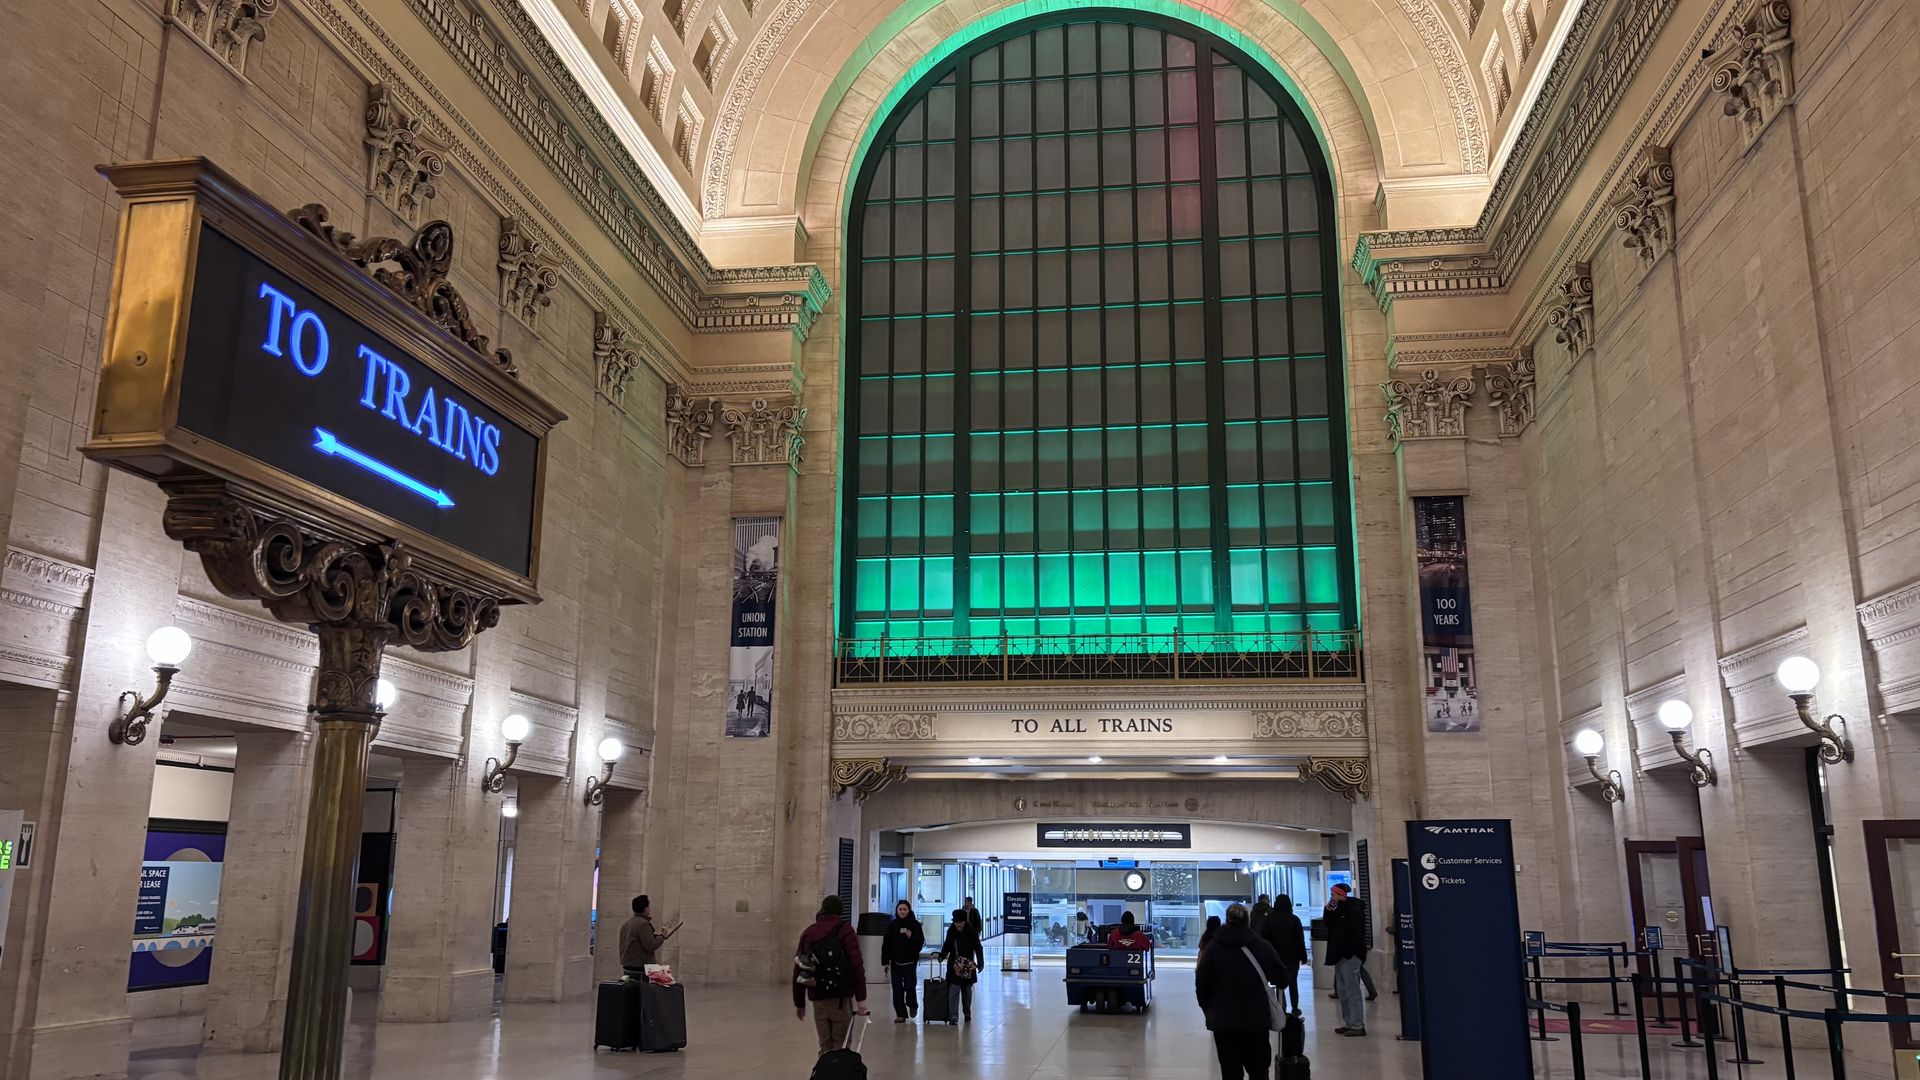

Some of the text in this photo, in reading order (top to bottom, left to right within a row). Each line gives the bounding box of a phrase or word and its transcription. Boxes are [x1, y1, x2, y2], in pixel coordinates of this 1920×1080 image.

[260, 282, 501, 476] TO TRAINS
[1436, 598, 1456, 609] 100
[741, 612, 766, 622] UNION
[1434, 614, 1459, 625] YEARS
[738, 627, 767, 637] STATION
[1011, 718, 1173, 733] TO ALL TRAINS
[1063, 828, 1165, 842] UNION STATION
[1473, 857, 1503, 865] Services
[148, 869, 167, 878] SPACE
[144, 881, 162, 889] LEASE
[1441, 877, 1466, 885] Tickets
[1127, 953, 1141, 964] 22
